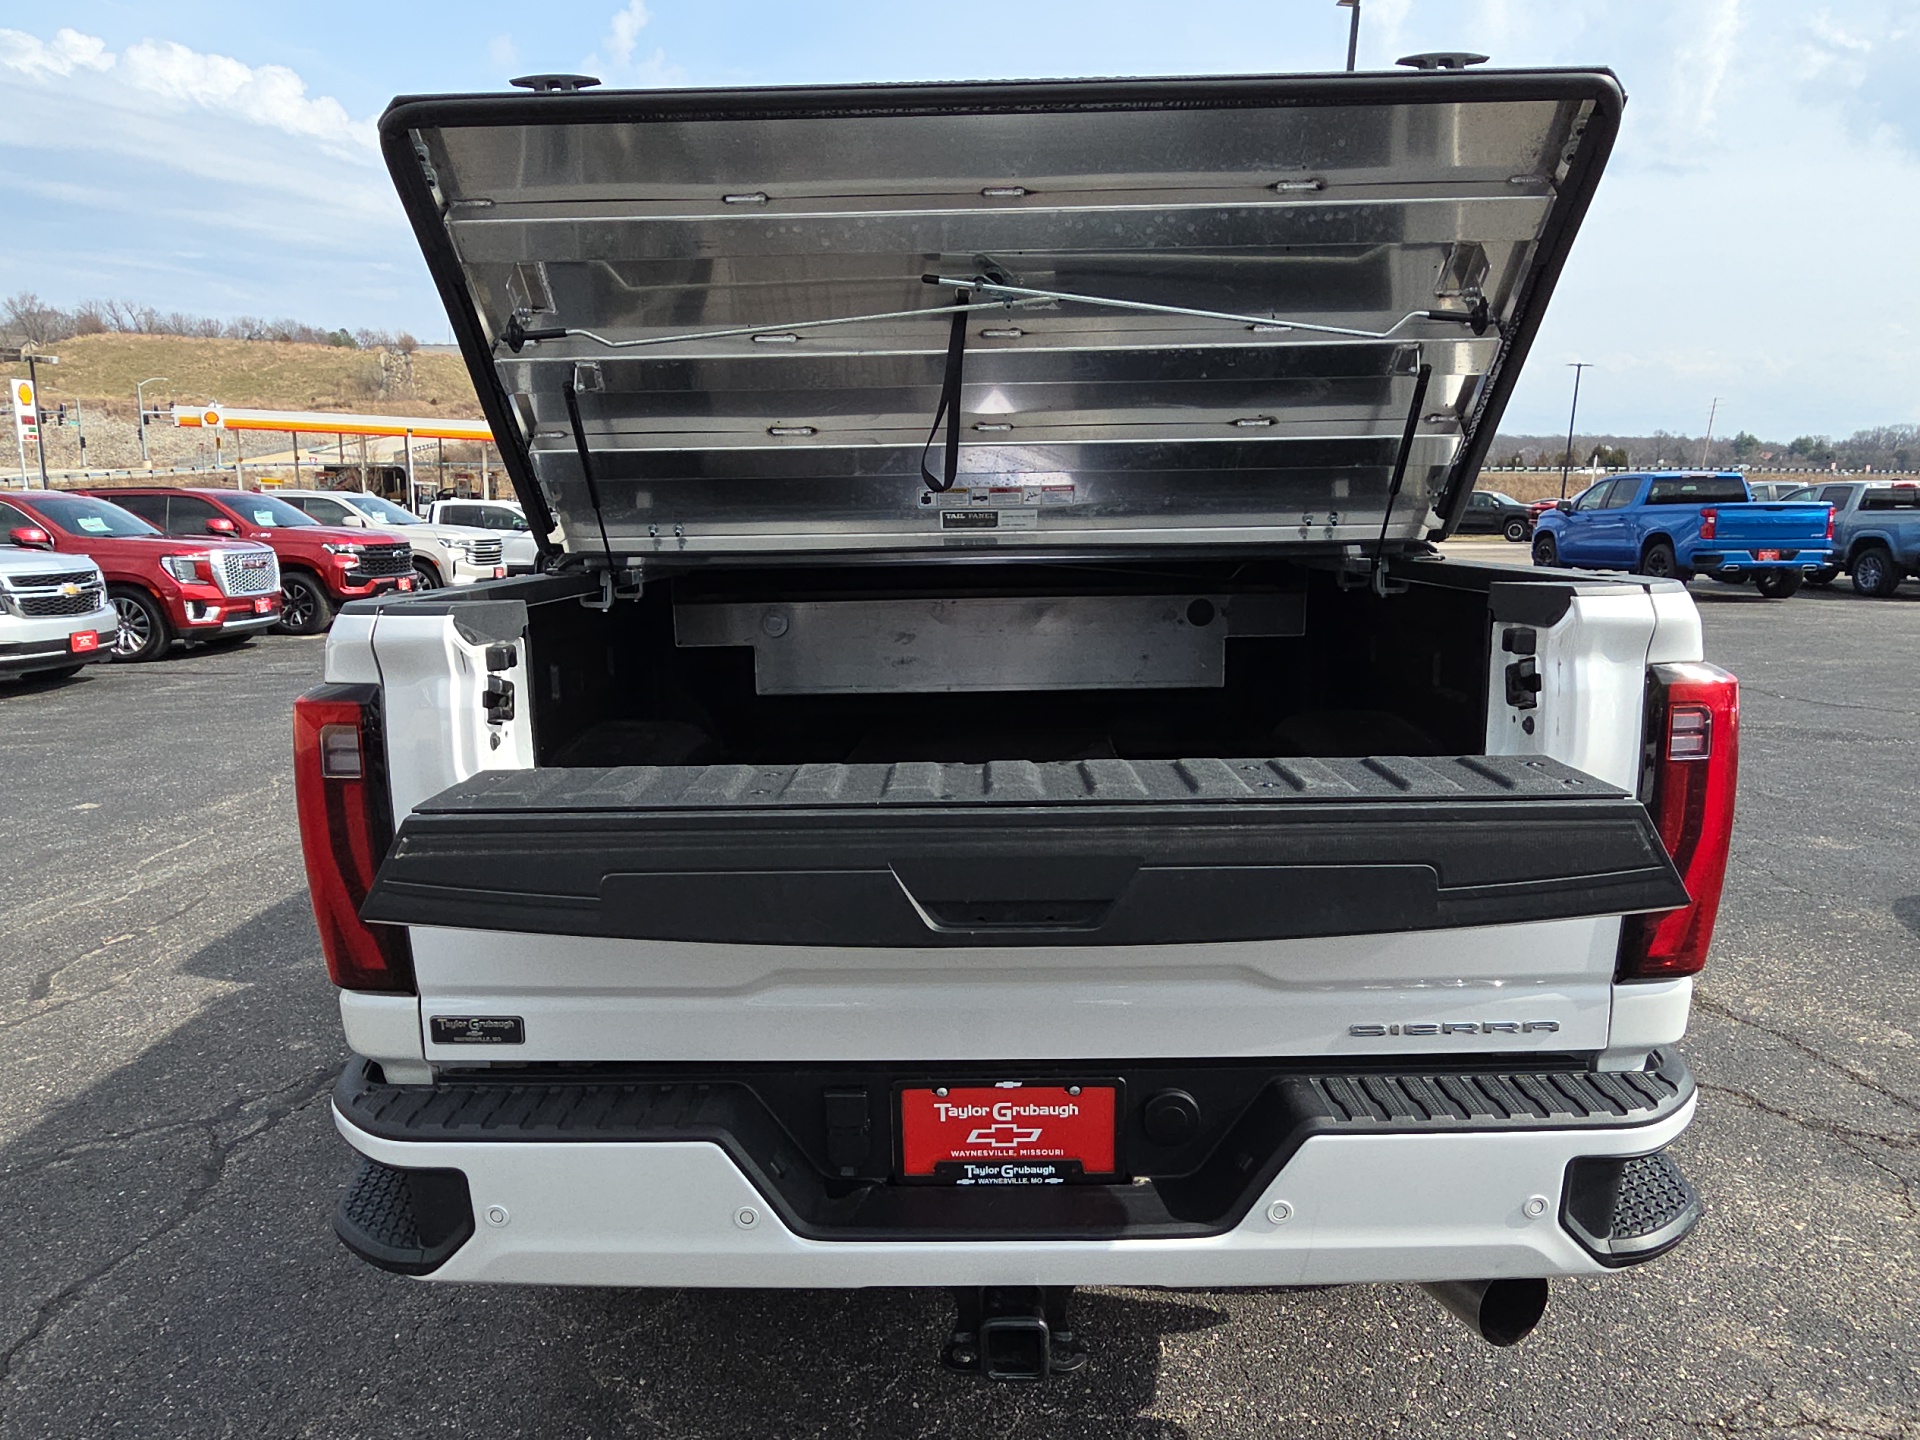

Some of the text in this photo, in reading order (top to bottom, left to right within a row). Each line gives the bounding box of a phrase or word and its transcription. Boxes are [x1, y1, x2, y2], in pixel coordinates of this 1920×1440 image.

[437, 1018, 514, 1030] Taylor Grubaugh
[1349, 1019, 1560, 1036] SIERRA
[933, 1102, 1079, 1122] Taylor Grubaugh
[950, 1148, 1064, 1157] WAYNESVILLE, MISSOURI
[964, 1164, 1055, 1178] Taylor Grubaugh
